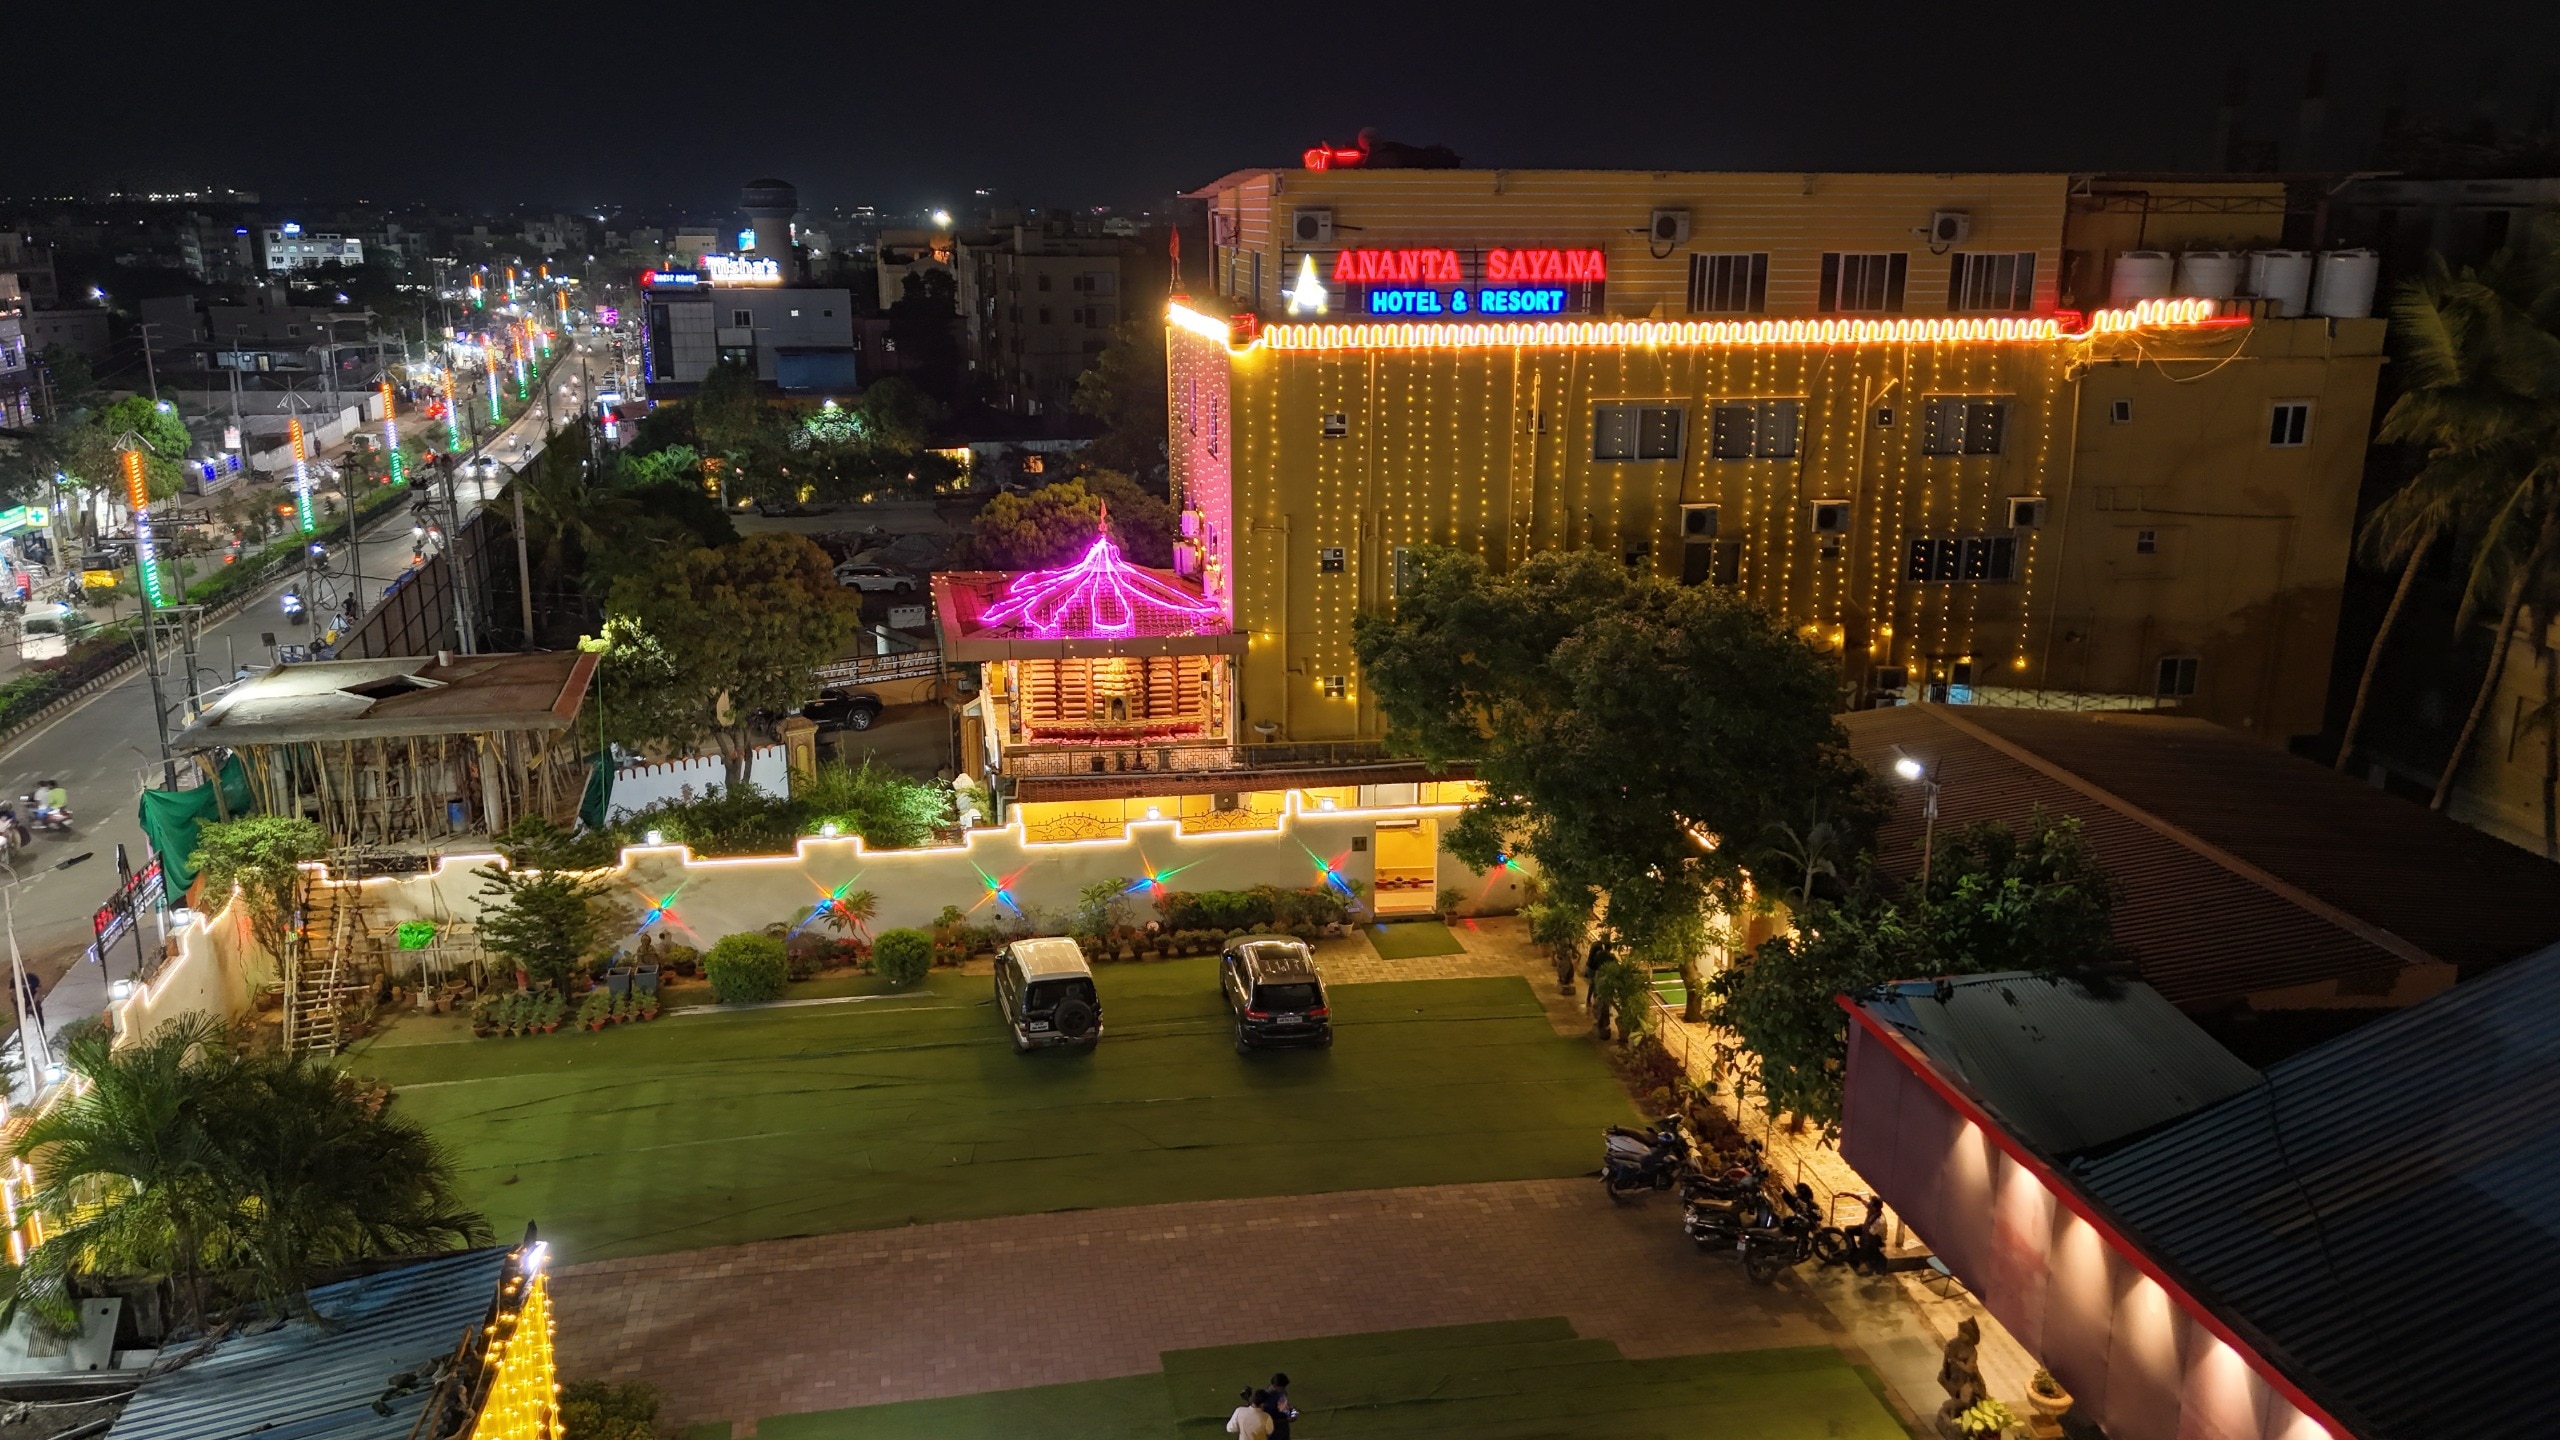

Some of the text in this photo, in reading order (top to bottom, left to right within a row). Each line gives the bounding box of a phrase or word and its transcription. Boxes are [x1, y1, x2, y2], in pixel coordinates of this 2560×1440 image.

[1334, 250, 1605, 280] ANANTA SAYANA
[1372, 290, 1563, 312] HOTEL & RESORT
